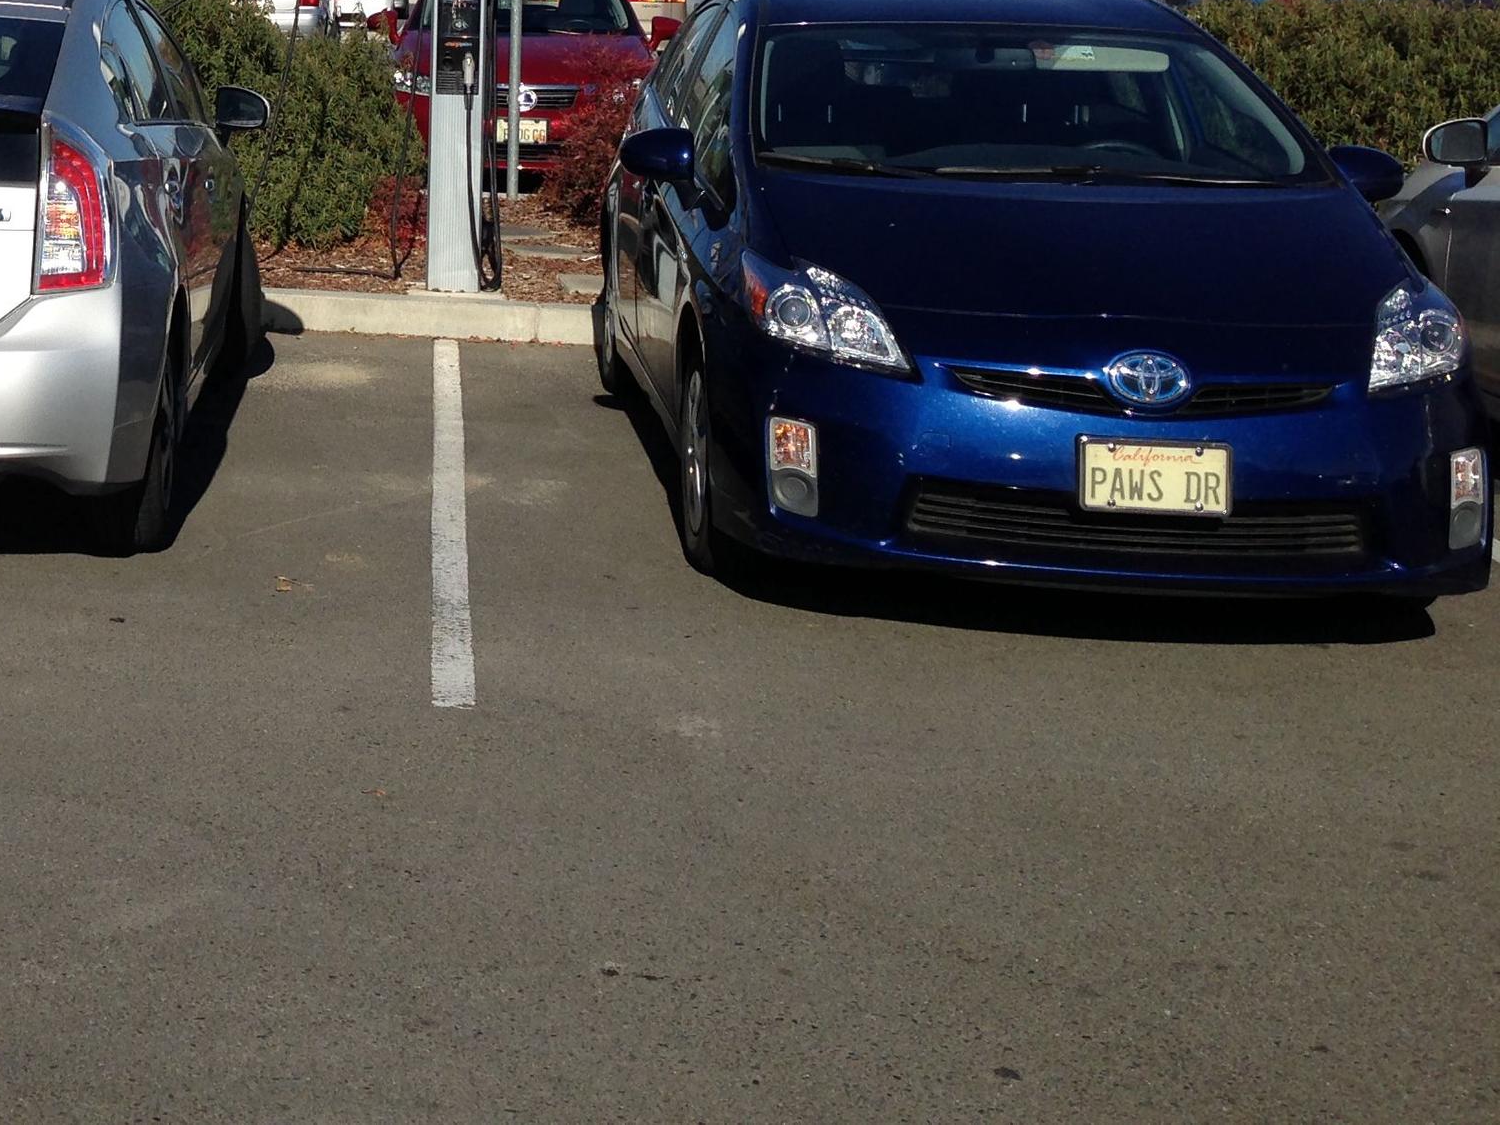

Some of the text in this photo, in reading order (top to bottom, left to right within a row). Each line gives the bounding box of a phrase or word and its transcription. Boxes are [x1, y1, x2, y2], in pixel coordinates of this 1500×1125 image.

[1112, 446, 1202, 466] California
[1090, 467, 1221, 506] PAWS DR
